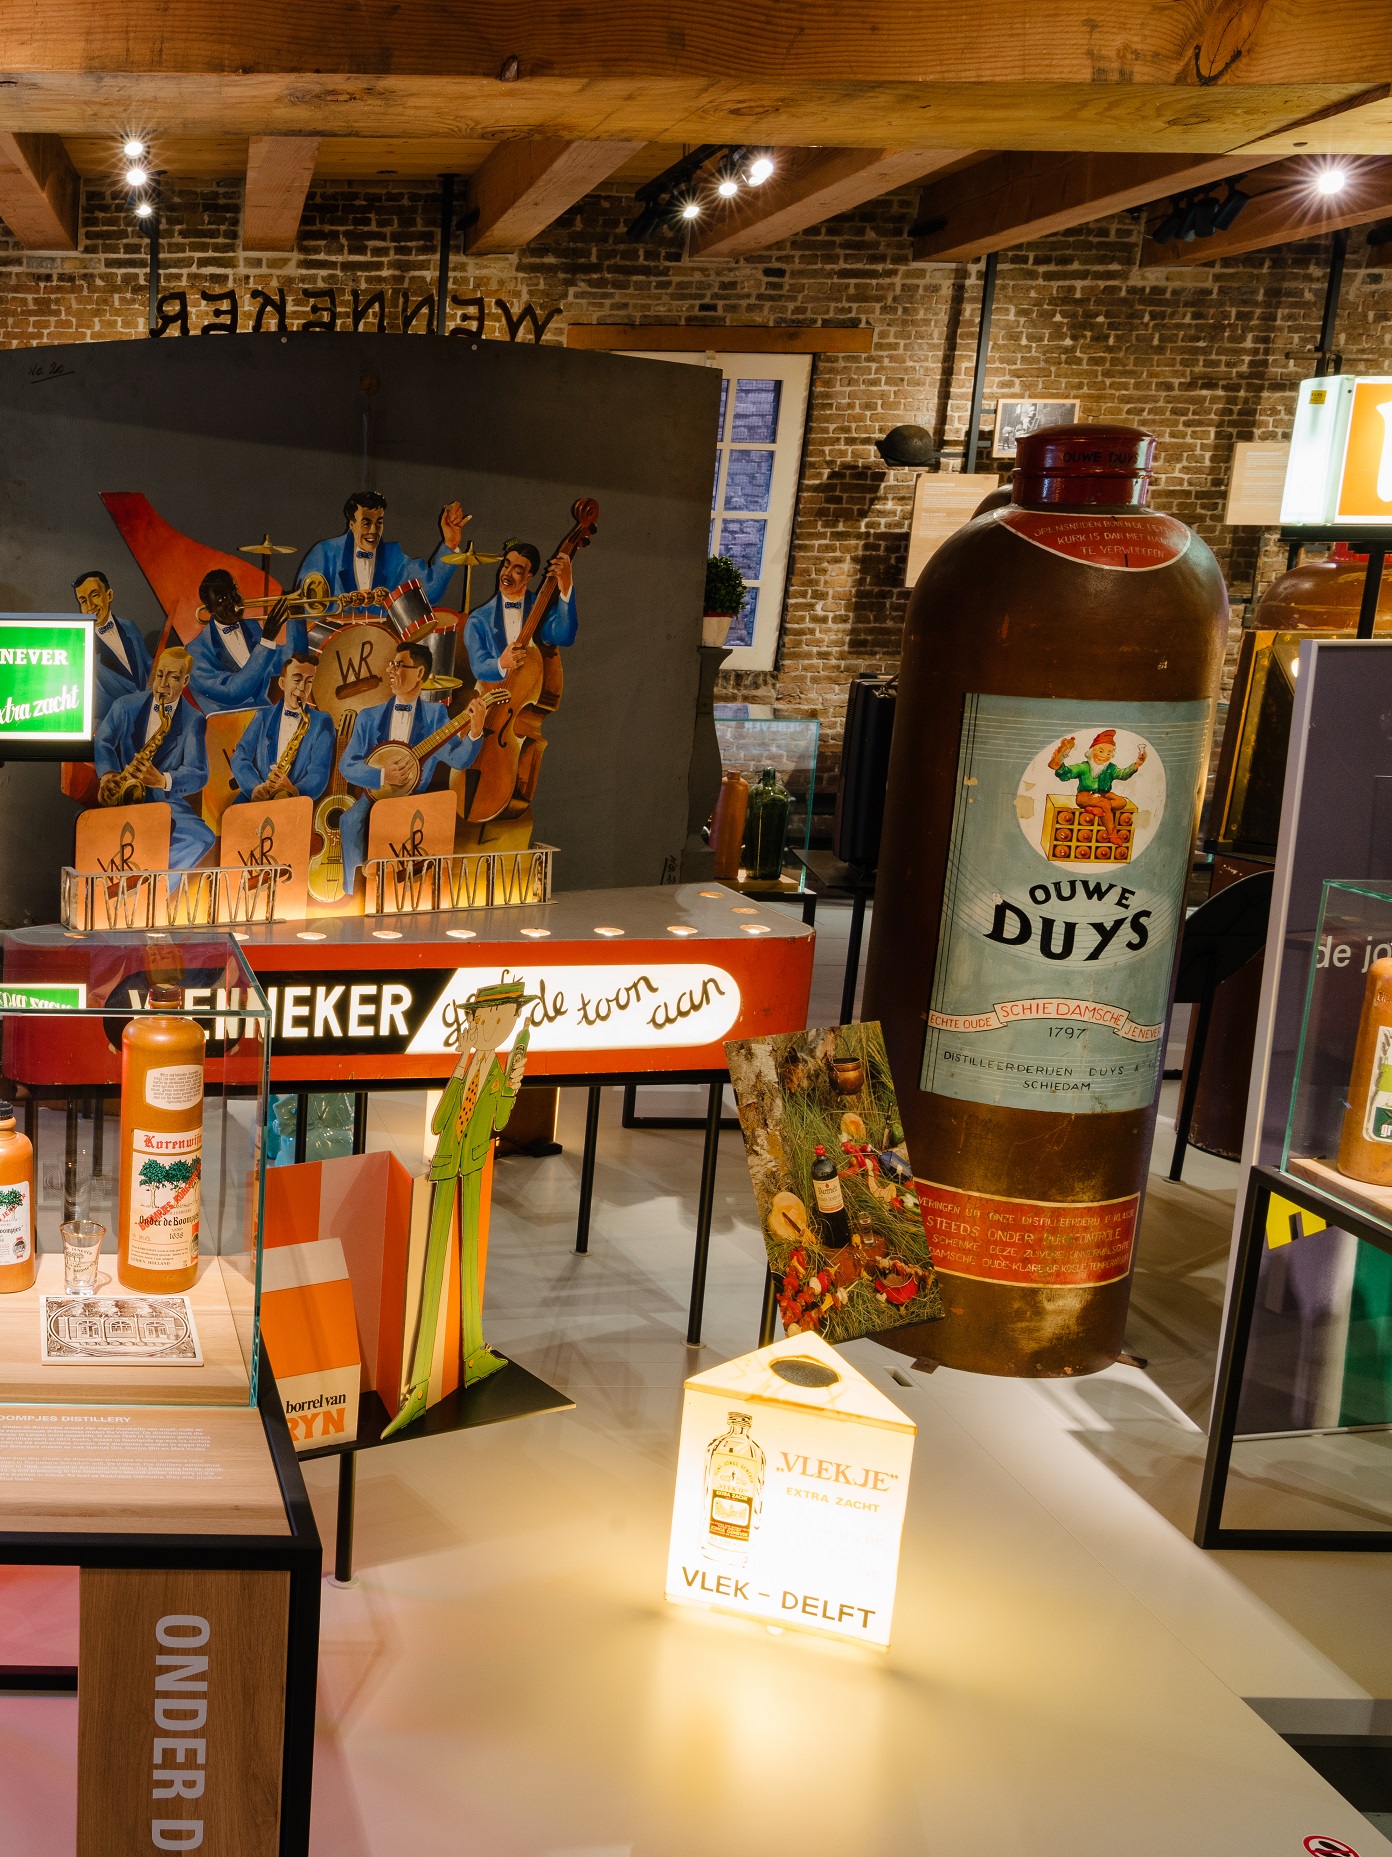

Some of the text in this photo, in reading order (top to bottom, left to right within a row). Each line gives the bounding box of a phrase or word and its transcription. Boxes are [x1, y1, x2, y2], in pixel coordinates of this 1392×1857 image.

[32, 684, 80, 718] zacht
[1028, 879, 1137, 910] OUWE
[982, 899, 1153, 962] DUYS
[1316, 935, 1351, 969] de
[442, 974, 726, 1049] gde toon aan
[930, 1012, 960, 1029] ECHTE
[963, 1016, 993, 1030] OUDE
[1000, 1002, 1125, 1026] SCHIEDAMSCHE
[1048, 1026, 1087, 1040] 1797
[943, 1051, 1074, 1077] DISTILLEERDERIJEN
[1089, 1066, 1125, 1077] DUYS
[1022, 1080, 1092, 1092] SCHIEDAM
[926, 1215, 981, 1237] STEEDS
[987, 1228, 1034, 1245] ONDER
[932, 1233, 981, 1252] SCHENKE
[989, 1245, 1018, 1257] DEZE
[286, 1393, 347, 1415] borrel van
[61, 1415, 131, 1423] DISTILLERY
[786, 1487, 881, 1513] EXTRA ZACHT
[681, 1565, 877, 1629] VLEK DELFT
[151, 1612, 211, 1801] ONDER
